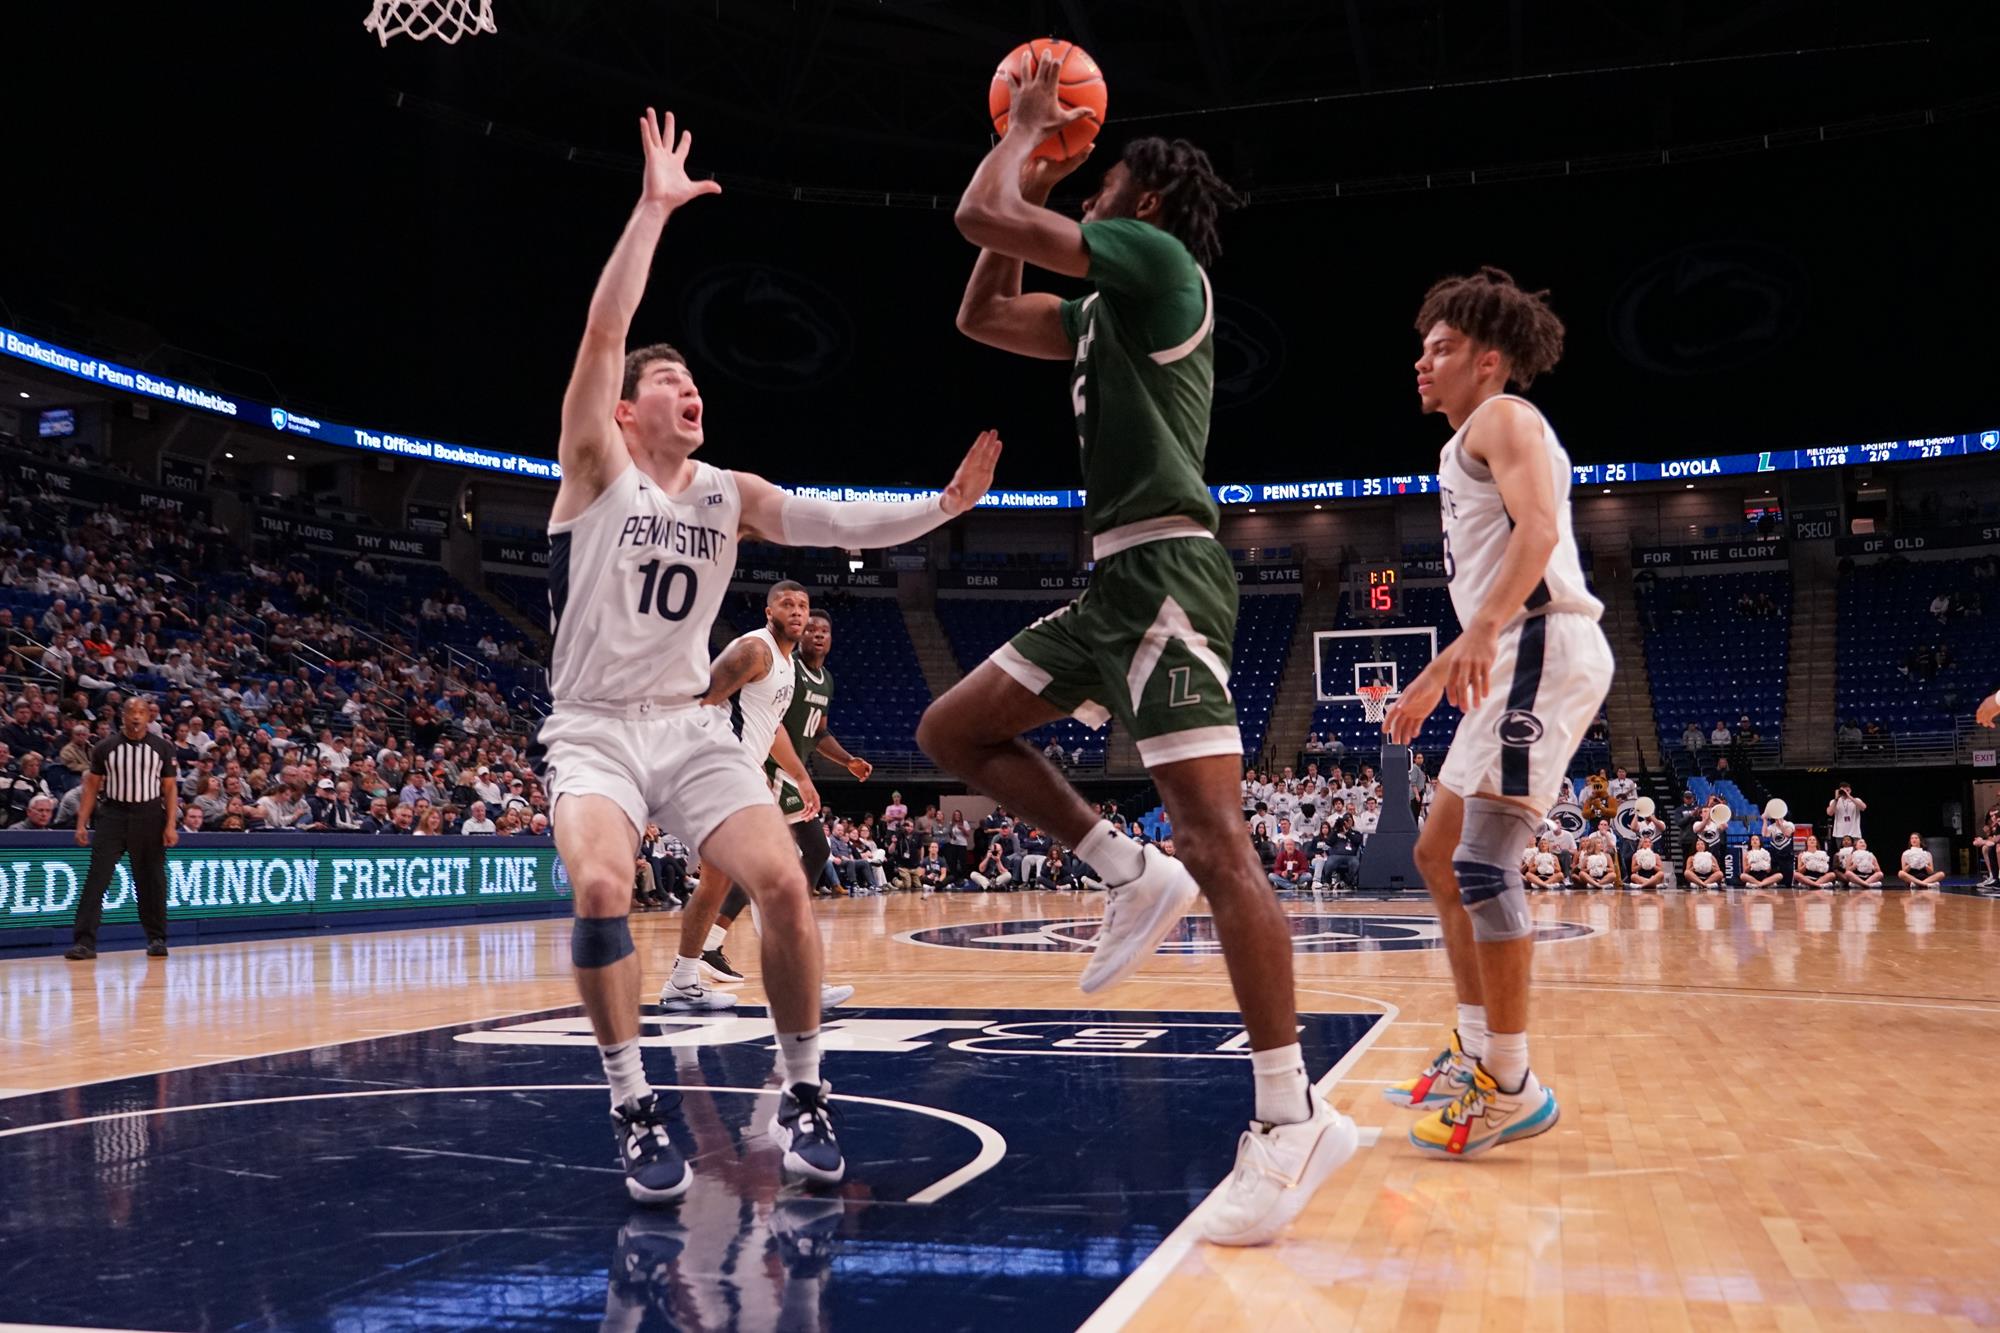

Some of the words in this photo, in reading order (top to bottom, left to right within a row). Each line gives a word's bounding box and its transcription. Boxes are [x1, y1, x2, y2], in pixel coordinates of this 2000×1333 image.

[7, 334, 79, 371] Bookstore
[80, 362, 97, 377] of
[99, 364, 134, 388] Penn
[136, 374, 175, 399] State
[176, 385, 237, 415] Athletics
[354, 430, 381, 449] The
[383, 435, 432, 457] Official
[434, 443, 501, 468] Bookstore
[502, 456, 517, 470] of
[518, 458, 549, 476] Penn
[1811, 454, 1846, 467] 11/28
[1869, 450, 1890, 462] 2/9
[1921, 446, 1942, 458] 2/3
[1573, 465, 1594, 474] FOULS
[1605, 464, 1627, 481] 26
[1660, 459, 1721, 477] LOYOLA
[1362, 478, 1381, 495] 35
[1392, 476, 1412, 484] FOULS
[1580, 473, 1587, 483] 5
[796, 487, 842, 501] Official
[845, 488, 911, 502] Bookstore
[1001, 493, 1059, 506] Athletics
[1263, 485, 1299, 500] PENN
[1301, 482, 1343, 498] STATE
[260, 516, 290, 532] THAT
[297, 524, 334, 541] LOVES
[618, 515, 671, 549] PENN
[1797, 520, 1831, 539] PSECU
[355, 534, 382, 548] THY
[389, 539, 425, 555] NAME
[1863, 540, 1884, 552] OF
[1894, 537, 1925, 550] OLD
[501, 548, 525, 560] MAY
[1643, 552, 1671, 564] FOR
[1691, 549, 1720, 561] THE
[1728, 545, 1777, 559] GLORY
[816, 573, 840, 584] THY
[847, 573, 880, 585] FAME
[966, 575, 998, 586] DEAR
[1040, 577, 1064, 588] OLD
[1259, 568, 1301, 581] STATE
[1370, 569, 1395, 585] 1:17
[637, 558, 698, 622] 10
[1369, 585, 1393, 612] 15
[1168, 665, 1201, 708] L
[803, 706, 822, 738] 10
[1974, 753, 1993, 762] EXIT
[102, 858, 319, 910] DMINION
[331, 857, 470, 901] FREIGHT
[479, 857, 538, 895] LINE
